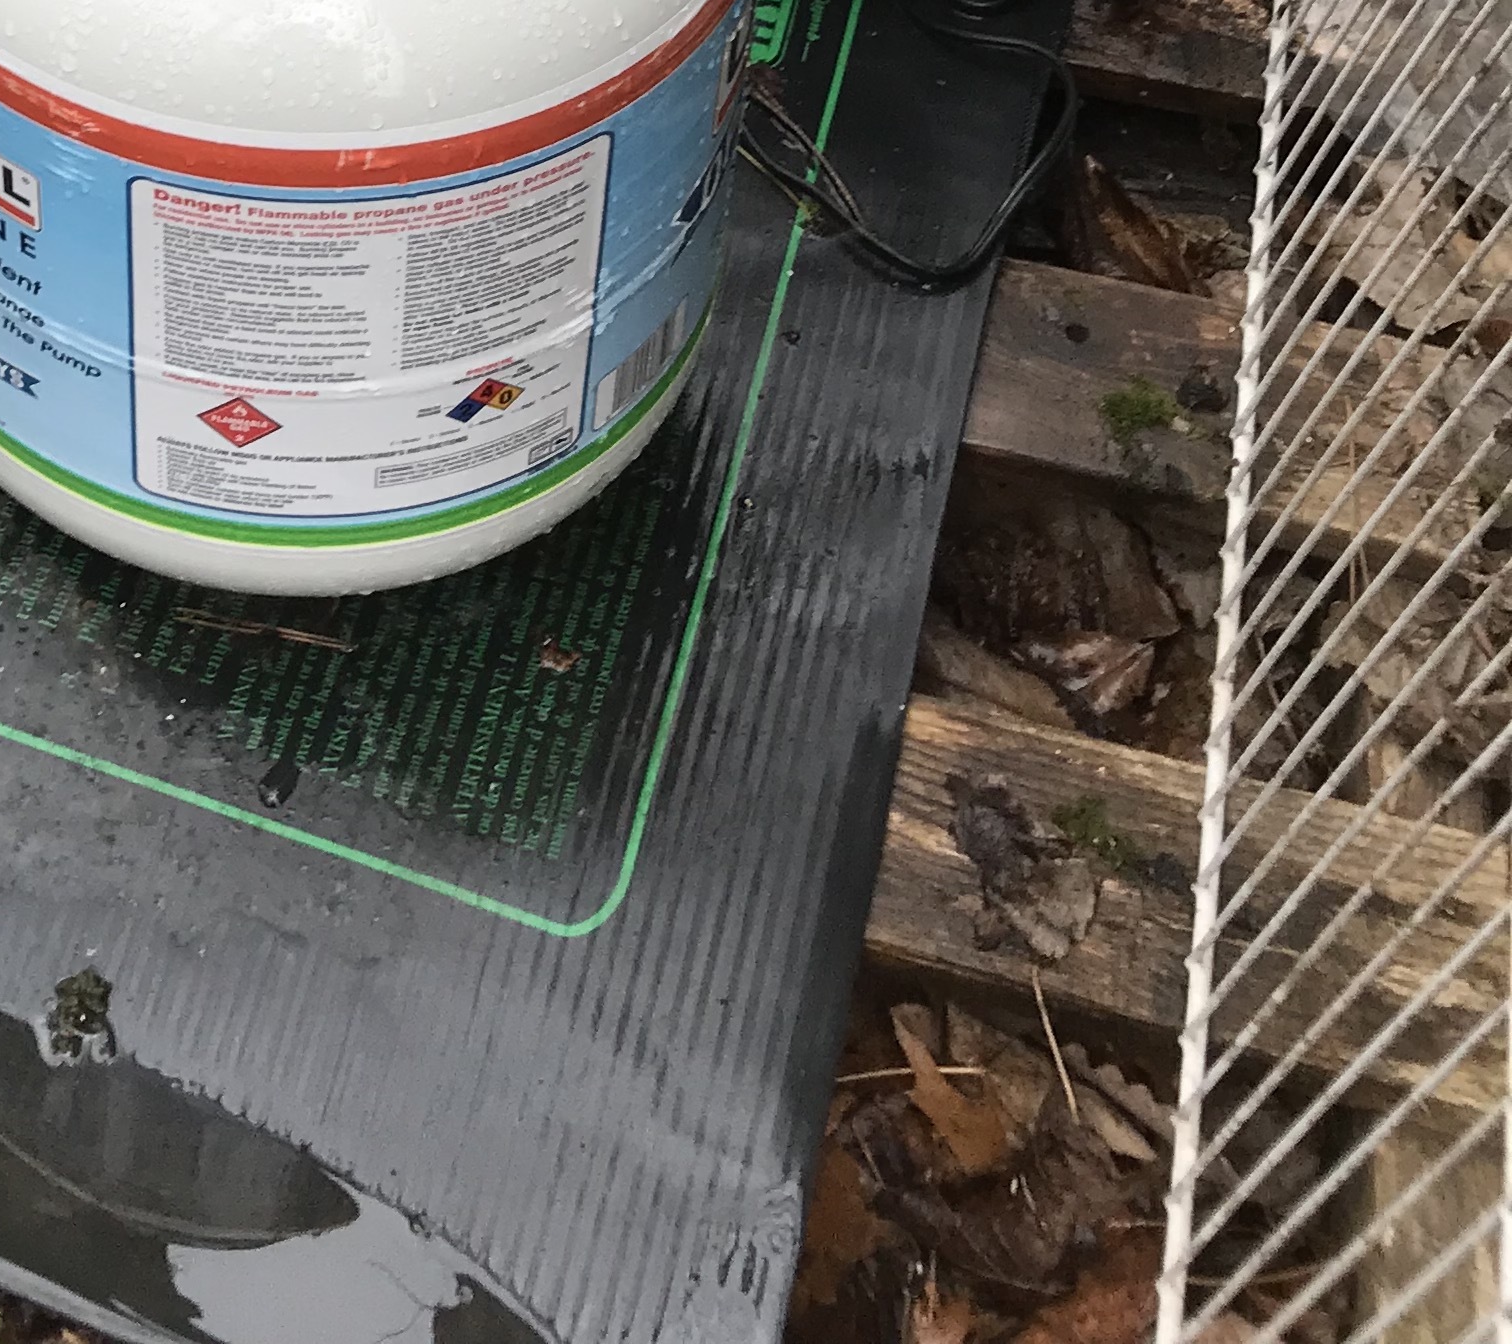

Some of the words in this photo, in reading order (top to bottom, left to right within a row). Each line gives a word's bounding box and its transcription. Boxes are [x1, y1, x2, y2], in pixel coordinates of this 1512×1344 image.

[153, 188, 241, 215] Danger!
[248, 207, 348, 221] Flammable
[353, 202, 426, 220] propane
[434, 196, 464, 212] gas
[469, 184, 519, 203] under
[1, 318, 34, 345] The
[40, 340, 102, 378] Pump
